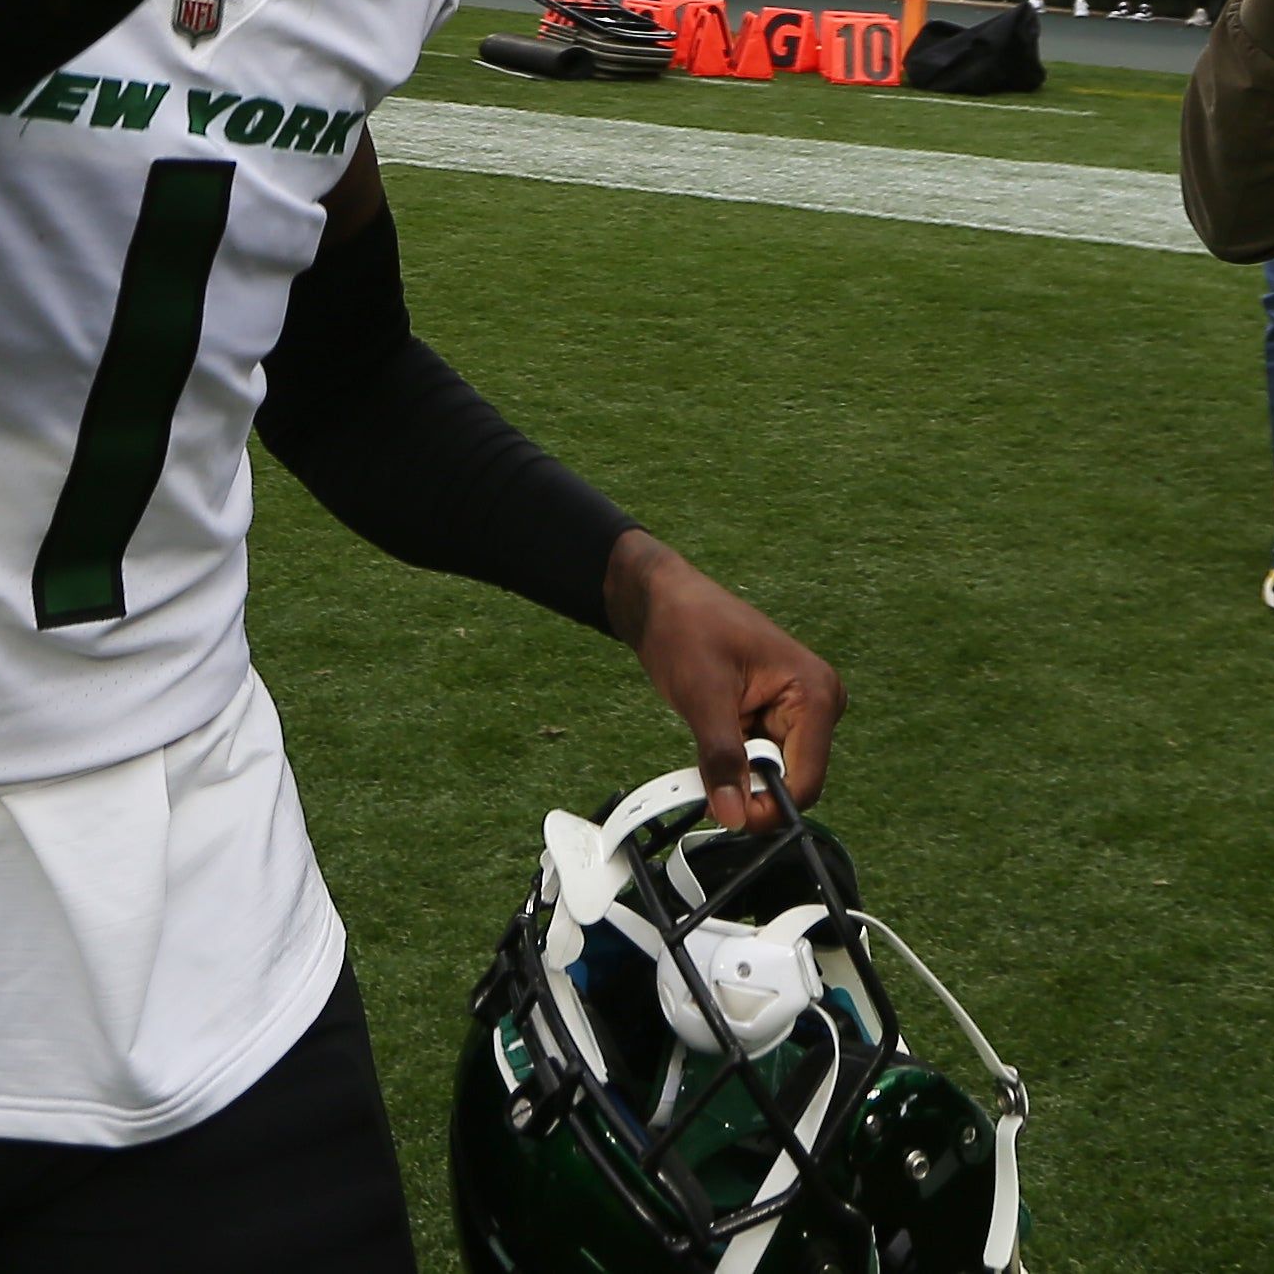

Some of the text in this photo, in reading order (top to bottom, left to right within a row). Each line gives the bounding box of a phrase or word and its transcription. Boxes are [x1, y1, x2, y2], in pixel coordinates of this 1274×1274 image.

[765, 13, 803, 68] G
[836, 23, 893, 82] 10
[187, 89, 365, 155] YORK
[31, 158, 237, 631] 1
